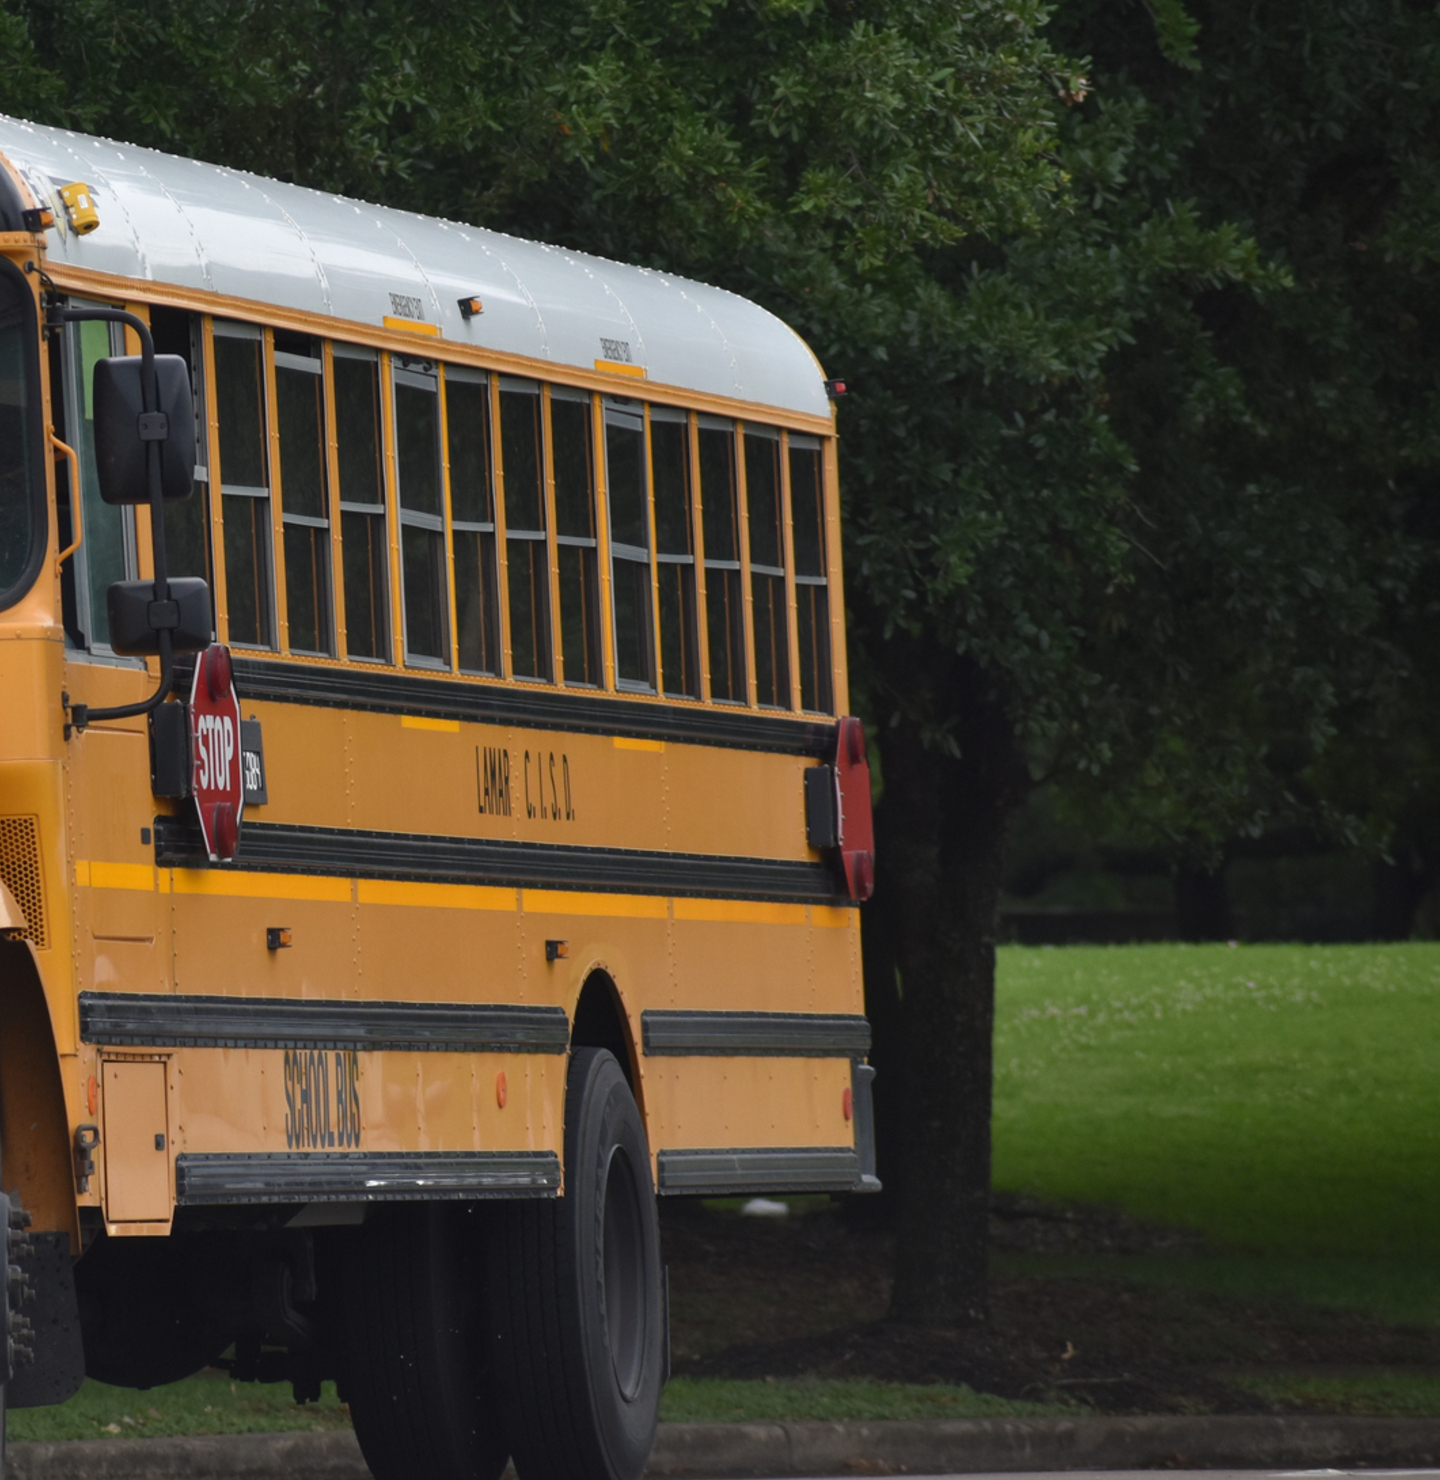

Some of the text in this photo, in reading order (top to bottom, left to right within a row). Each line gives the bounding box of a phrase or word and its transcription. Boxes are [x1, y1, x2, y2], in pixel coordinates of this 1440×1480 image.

[198, 714, 234, 791] STOP
[475, 745, 512, 817] LAMAR
[284, 1049, 360, 1149] SCHOOL BUS
